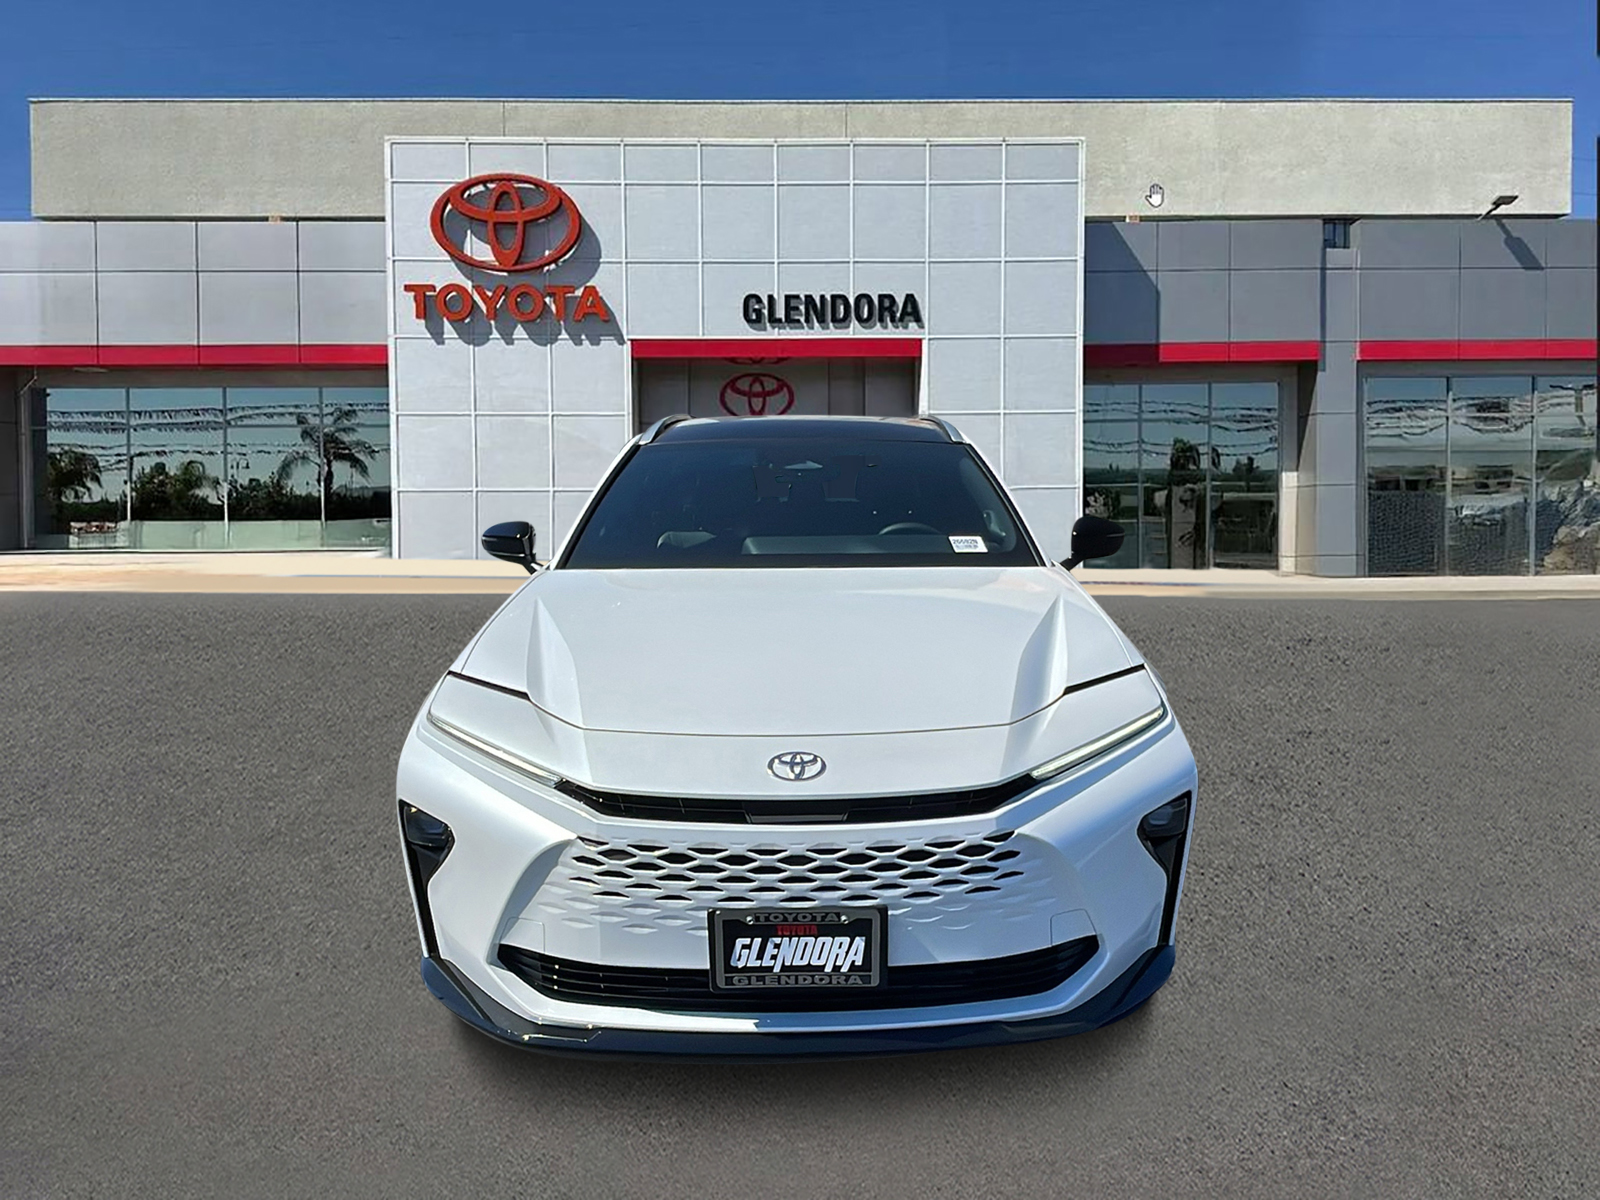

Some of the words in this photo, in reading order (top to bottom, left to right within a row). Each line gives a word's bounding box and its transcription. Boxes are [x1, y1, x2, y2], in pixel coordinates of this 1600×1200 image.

[404, 283, 610, 322] TOYOTA
[743, 293, 924, 325] GLENDORA
[755, 913, 839, 923] TOYOTA
[776, 925, 818, 936] TOYOTA
[730, 936, 866, 973] GLENDORA
[732, 975, 863, 986] GLENDORA
